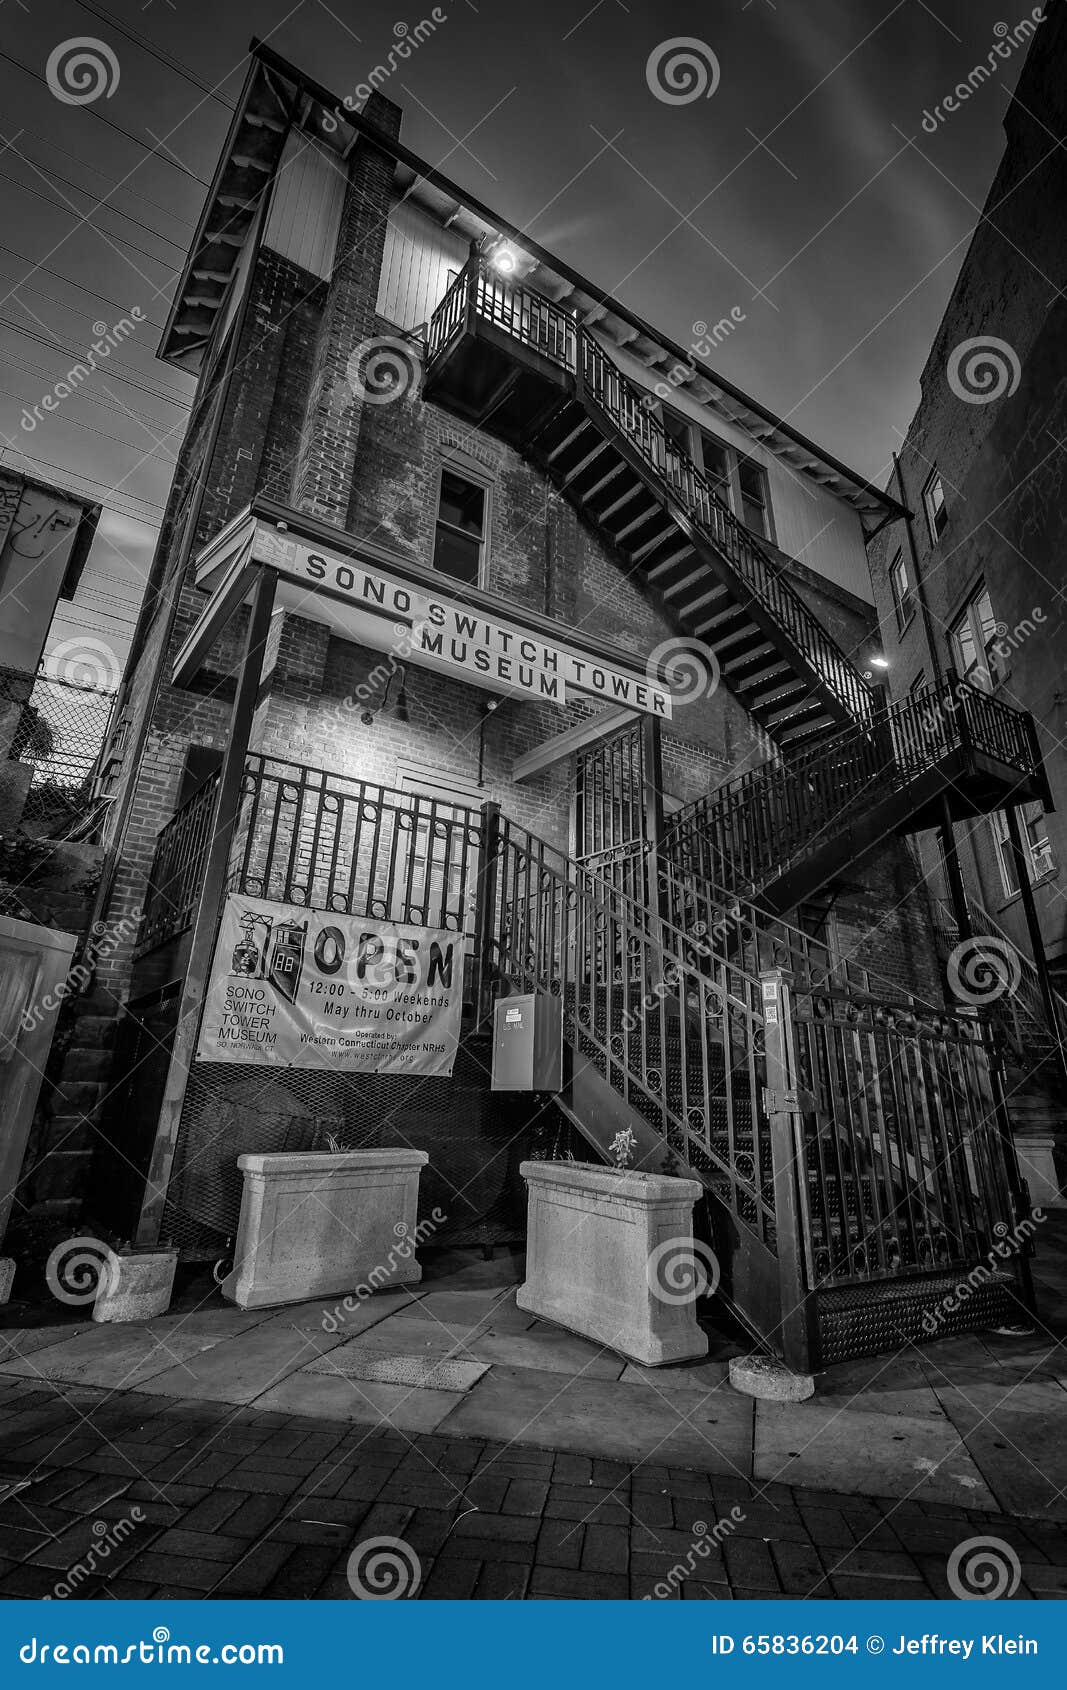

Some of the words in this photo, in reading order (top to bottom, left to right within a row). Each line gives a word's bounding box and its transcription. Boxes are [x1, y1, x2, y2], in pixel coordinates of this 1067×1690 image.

[306, 554, 411, 613] SONO
[428, 603, 558, 673] SWITCH
[572, 659, 666, 714] TOWER
[421, 628, 558, 699] MUSEUM
[314, 926, 454, 989] OPEN
[226, 985, 265, 1001] SONO
[310, 981, 345, 997] 12:00
[362, 987, 388, 1001] 5:00
[394, 990, 450, 1008] Weekends
[223, 999, 277, 1017] SWITCH
[324, 1001, 350, 1019] May
[355, 1005, 380, 1020] thru
[386, 1008, 434, 1024] October
[221, 1013, 271, 1030] TOWER
[218, 1027, 278, 1044] MUSEUM
[300, 1033, 336, 1046] Western
[338, 1037, 389, 1050] Connecticut
[422, 1042, 446, 1053] NRHS
[355, 1030, 385, 1040] Operated
